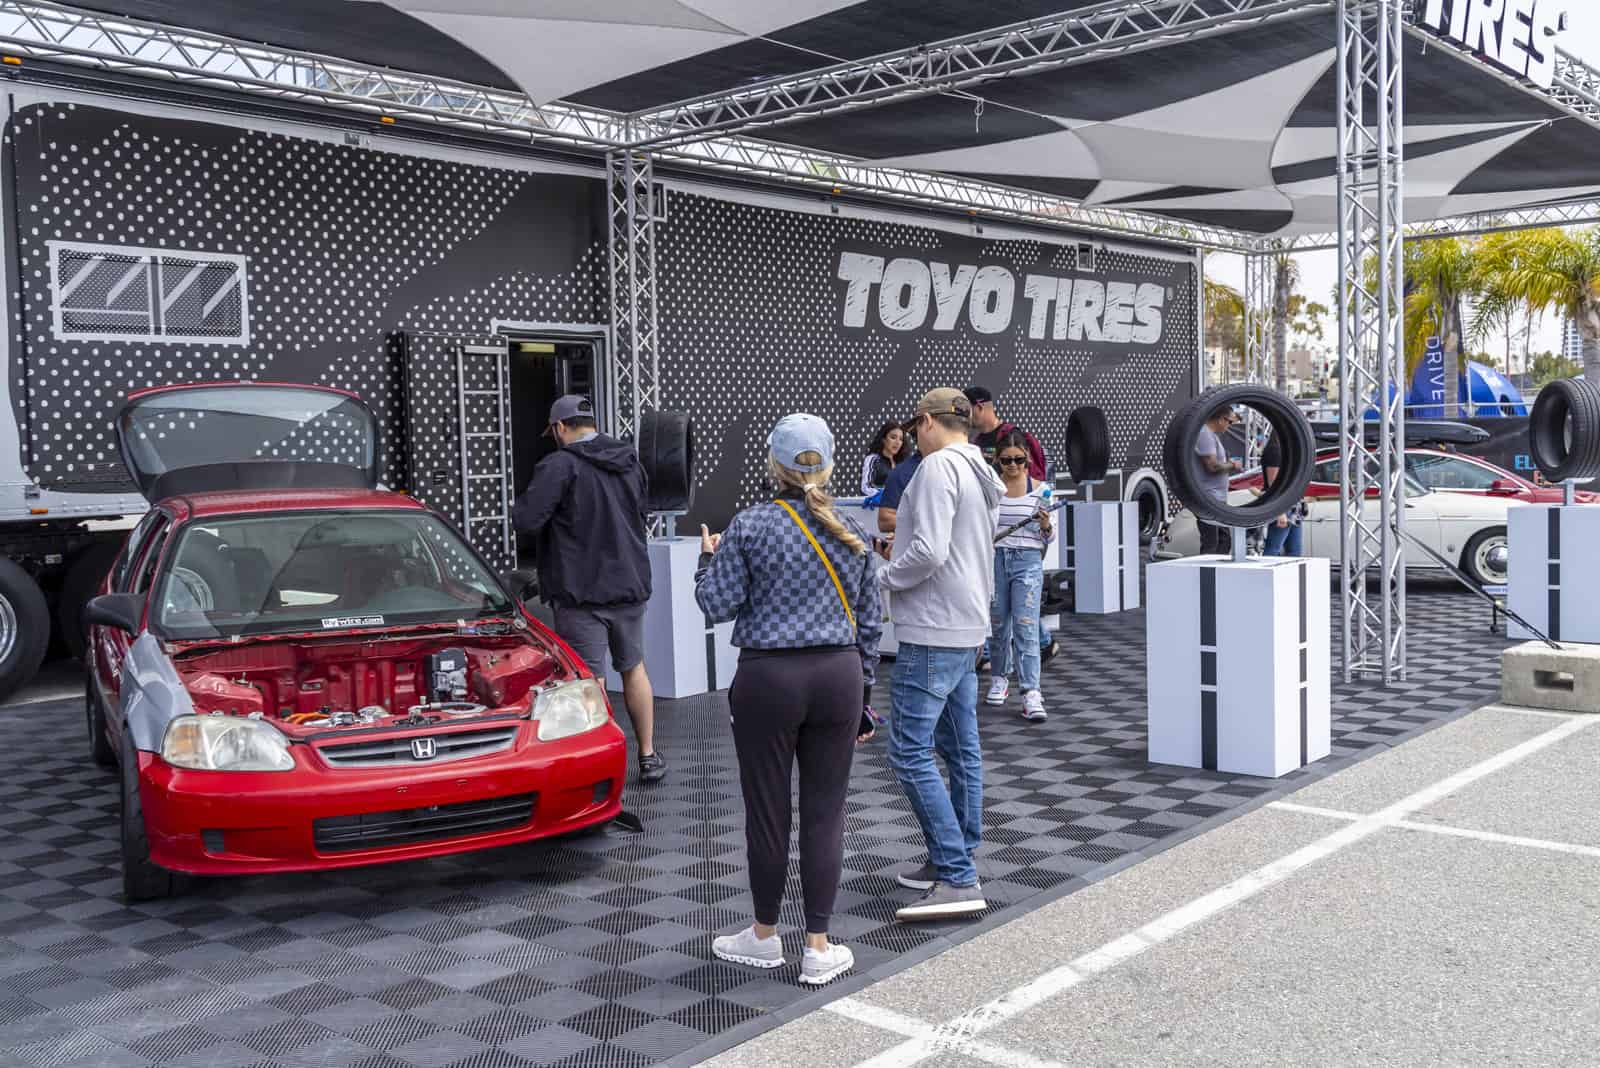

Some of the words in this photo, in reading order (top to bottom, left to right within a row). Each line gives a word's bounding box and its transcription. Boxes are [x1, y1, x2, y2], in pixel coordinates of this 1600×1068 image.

[837, 251, 1016, 334] TOYO
[1024, 274, 1165, 345] TIRES
[1425, 336, 1445, 401] DRIVE
